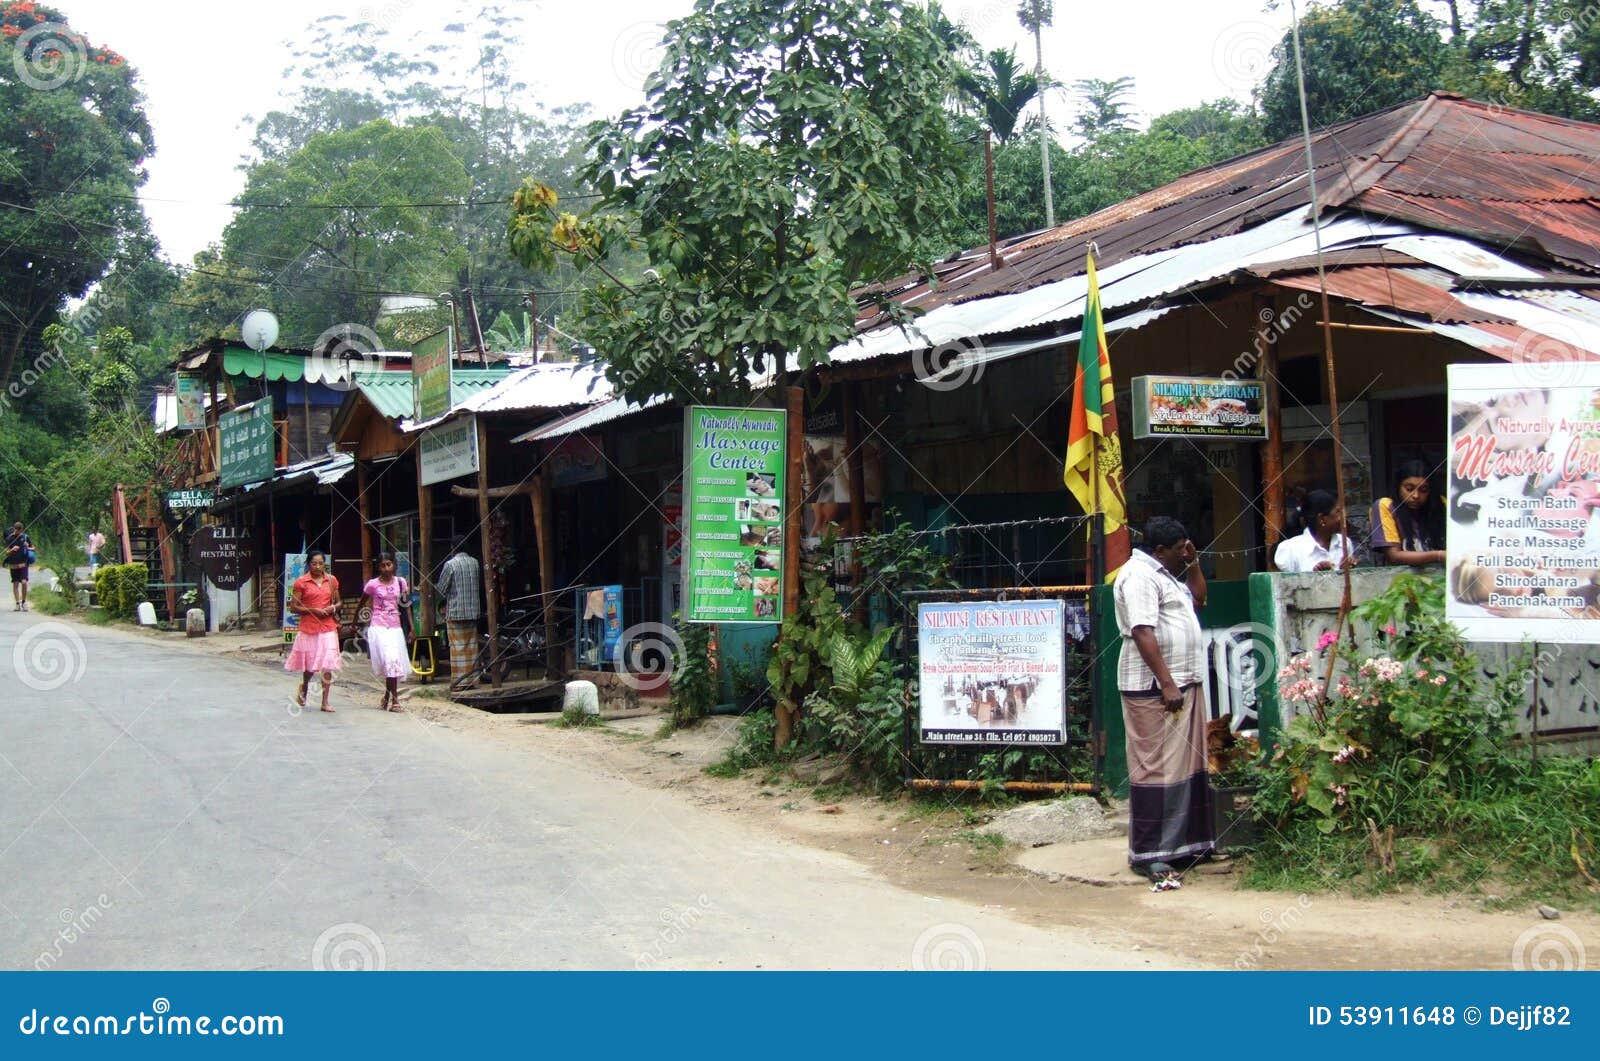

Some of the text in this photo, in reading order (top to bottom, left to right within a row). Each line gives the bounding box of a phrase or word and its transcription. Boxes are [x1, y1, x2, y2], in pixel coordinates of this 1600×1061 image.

[1153, 384, 1260, 398] NILMINI RESTAURANT
[701, 415, 778, 432] Naturally Ayurvedic
[1499, 418, 1555, 435] Naturally
[696, 431, 780, 455] Massage
[709, 451, 766, 470] Center
[1455, 434, 1556, 488] Massage
[181, 490, 202, 499] ELLA
[168, 499, 215, 508] RESTAURANT
[1497, 497, 1577, 509] Steam Bath
[1488, 516, 1587, 531] Head Massage
[213, 527, 251, 539] ELLA
[218, 543, 237, 551] VIEW
[1488, 536, 1586, 551] Face Massage
[1476, 555, 1599, 570] Full Body Tritment
[217, 575, 236, 583] BAR
[1495, 574, 1578, 588] Shirodahara
[1490, 594, 1584, 607] Panchakarma
[924, 608, 1057, 628] NILMINI RESTAURANT
